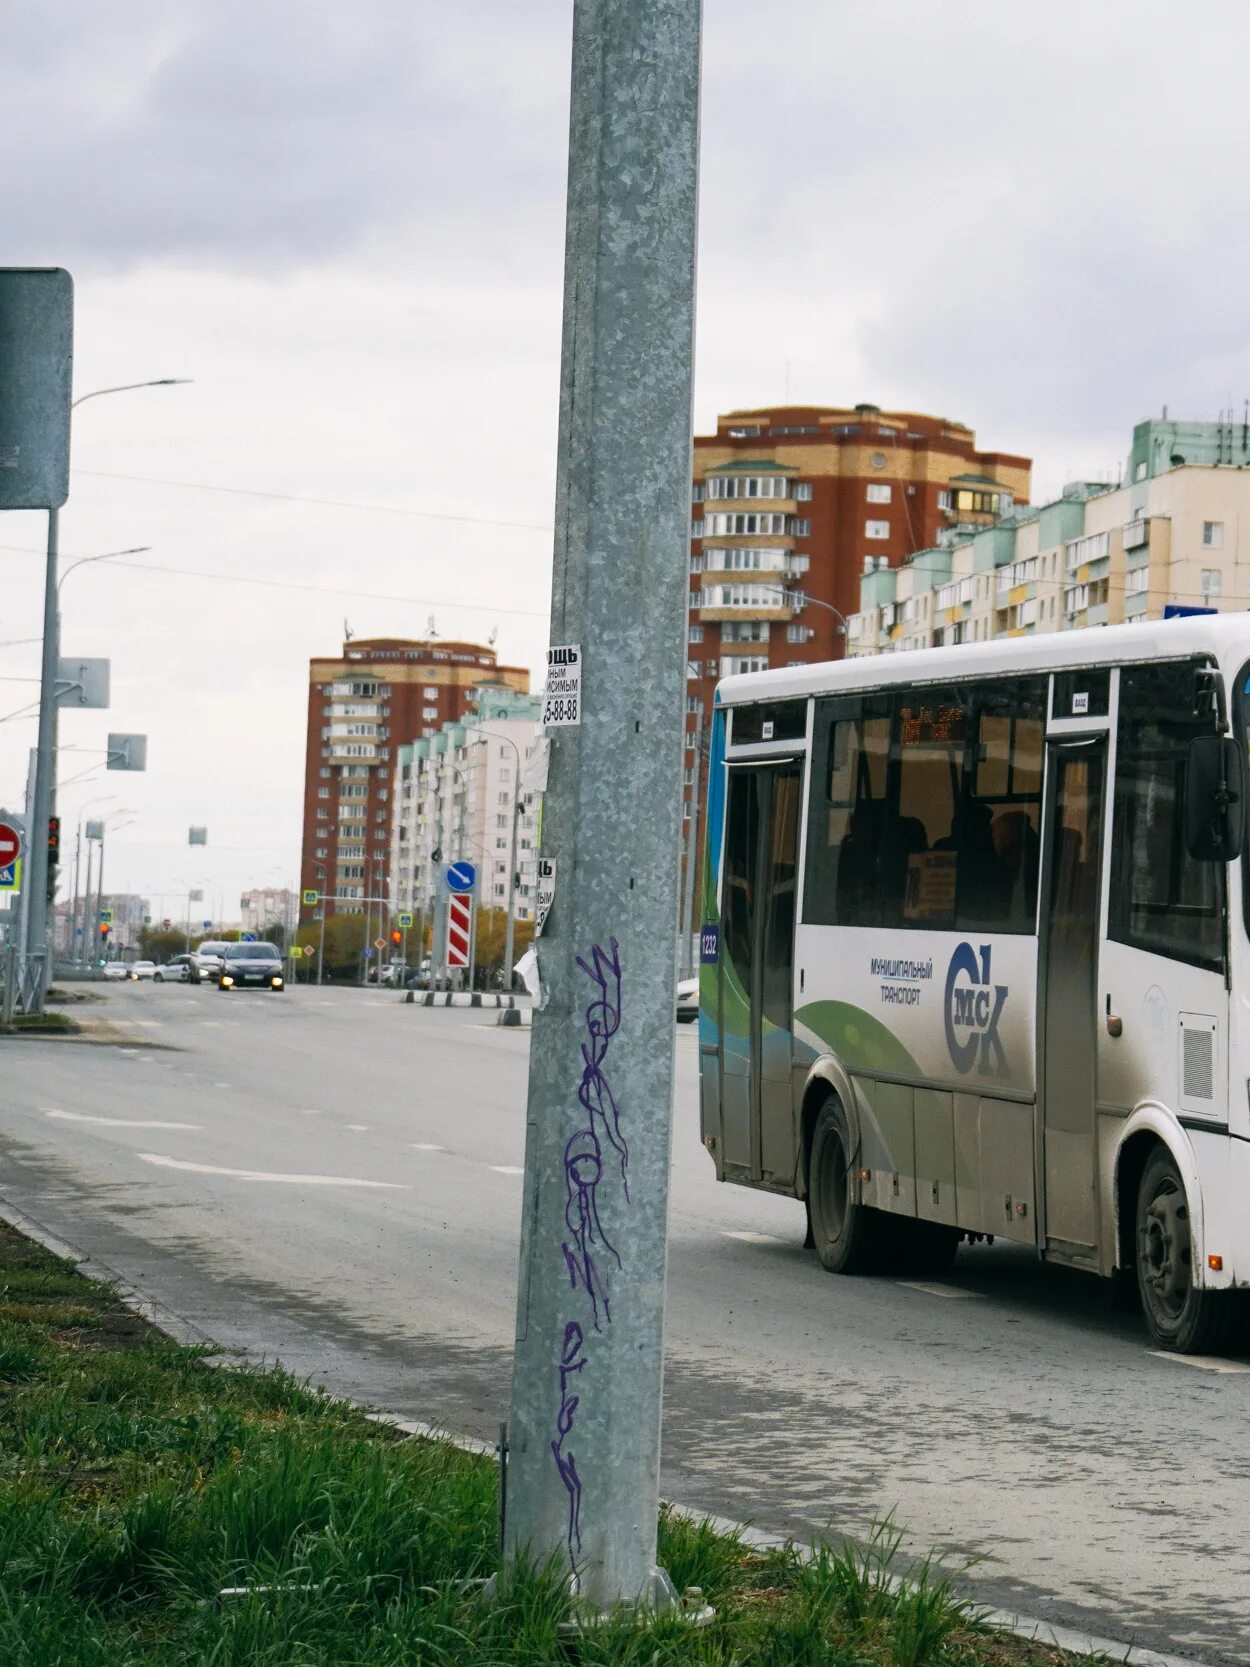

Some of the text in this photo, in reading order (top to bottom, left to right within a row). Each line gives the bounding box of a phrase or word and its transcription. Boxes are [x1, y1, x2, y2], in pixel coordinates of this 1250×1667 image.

[702, 935, 717, 955] 1232
[870, 958, 933, 979] МУНИЦИПАЛЬНЫЙ
[880, 985, 921, 1005] ТРАНСПОРТ
